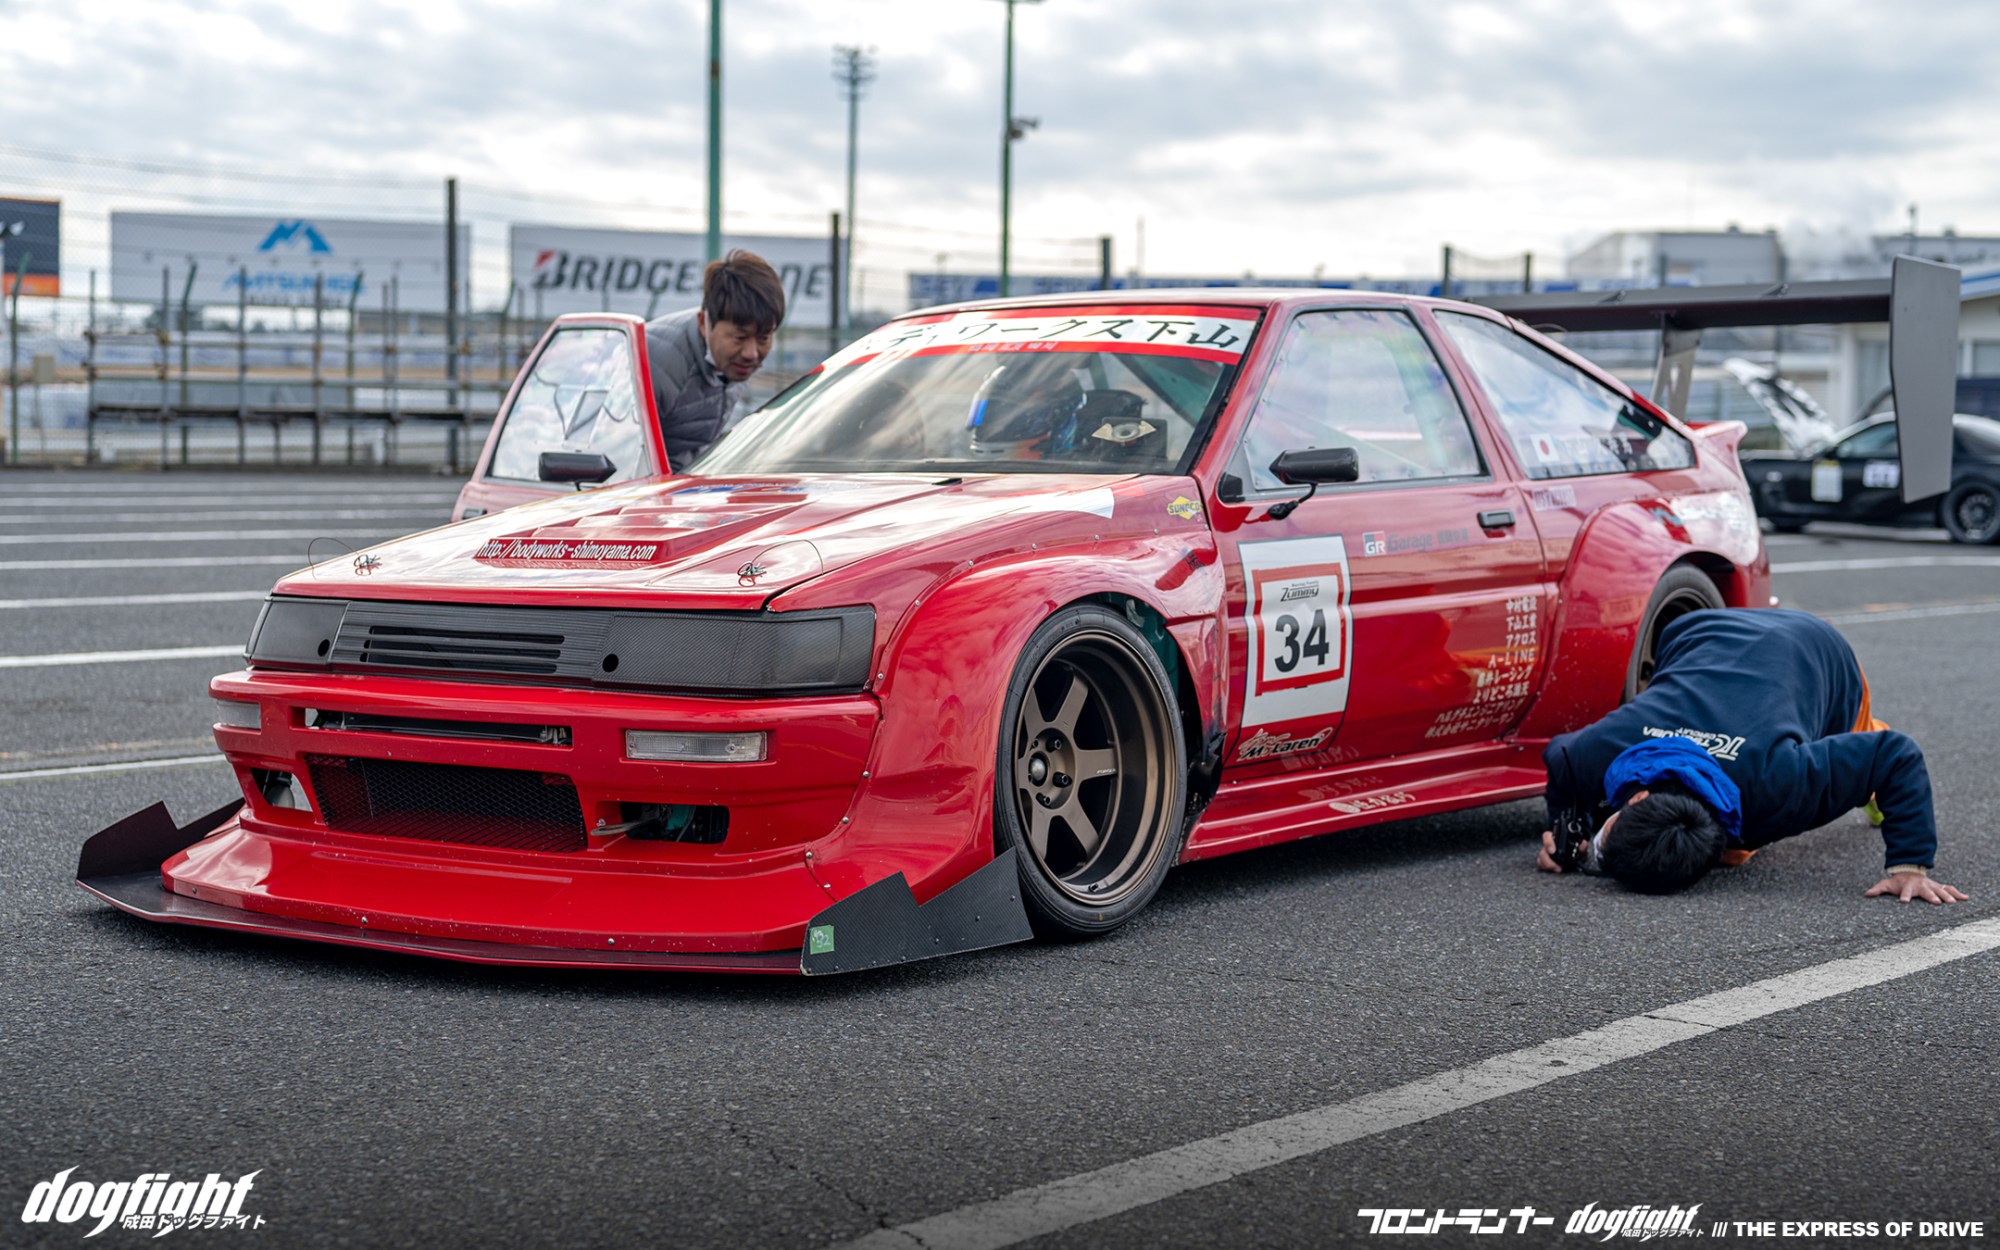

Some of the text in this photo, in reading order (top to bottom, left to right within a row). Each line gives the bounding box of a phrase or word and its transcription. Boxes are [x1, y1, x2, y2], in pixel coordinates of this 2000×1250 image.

[532, 249, 829, 298] BRIDGENE
[858, 318, 1241, 352] ディワークス下山
[477, 538, 657, 561] http://bodyworks-shimoyama.com
[1365, 541, 1386, 554] GR
[1388, 533, 1433, 553] Garage
[1274, 609, 1330, 672] 34
[1488, 648, 1536, 668] A-LINE
